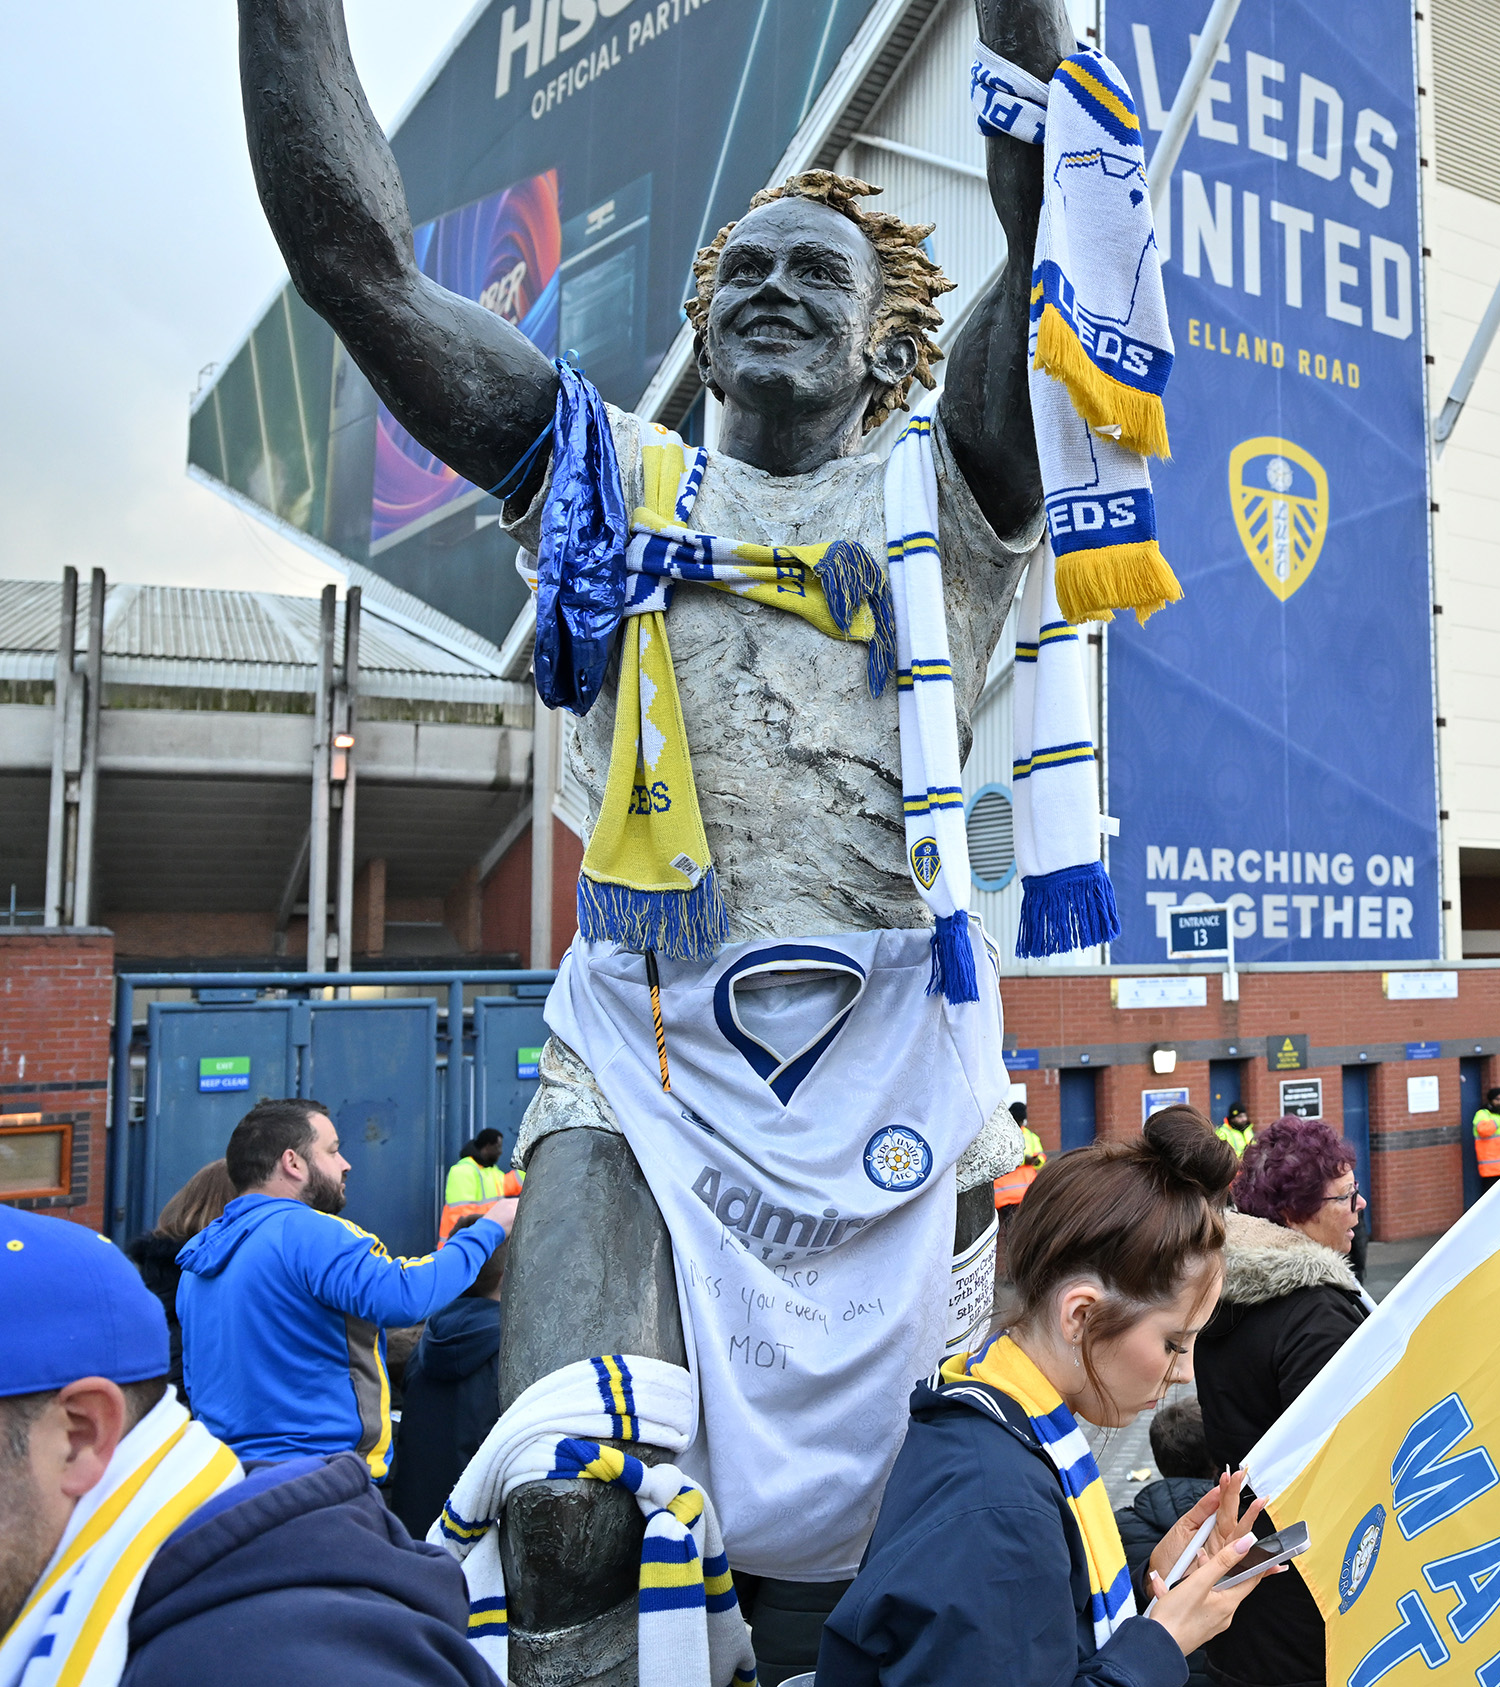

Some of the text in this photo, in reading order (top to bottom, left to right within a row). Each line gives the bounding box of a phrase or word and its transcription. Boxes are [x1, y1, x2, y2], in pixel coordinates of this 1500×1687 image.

[531, 0, 712, 120] OFFICIAL PARTN
[1131, 22, 1398, 209] LEEDS
[1059, 274, 1153, 377] LEDS
[1188, 318, 1361, 389] ELLAND ROAD
[1046, 496, 1137, 537] EDS
[1146, 845, 1415, 888] MARCHING ON
[1146, 891, 1414, 940] TGETHER
[1178, 914, 1220, 929] ENTRANCE
[1193, 928, 1209, 947] 13
[200, 1077, 249, 1088] KEEP CLEAR
[215, 1061, 234, 1072] EXIT
[877, 1138, 920, 1170] LEEDS UNITED
[894, 1170, 911, 1181] AFC
[690, 1165, 884, 1248] Admir
[948, 1286, 973, 1307] 17th
[955, 1267, 980, 1291] Tony
[741, 1287, 775, 1324] you
[785, 1299, 829, 1336] every
[843, 1298, 885, 1322] day
[956, 1302, 974, 1320] 5th
[729, 1335, 794, 1370] MOT
